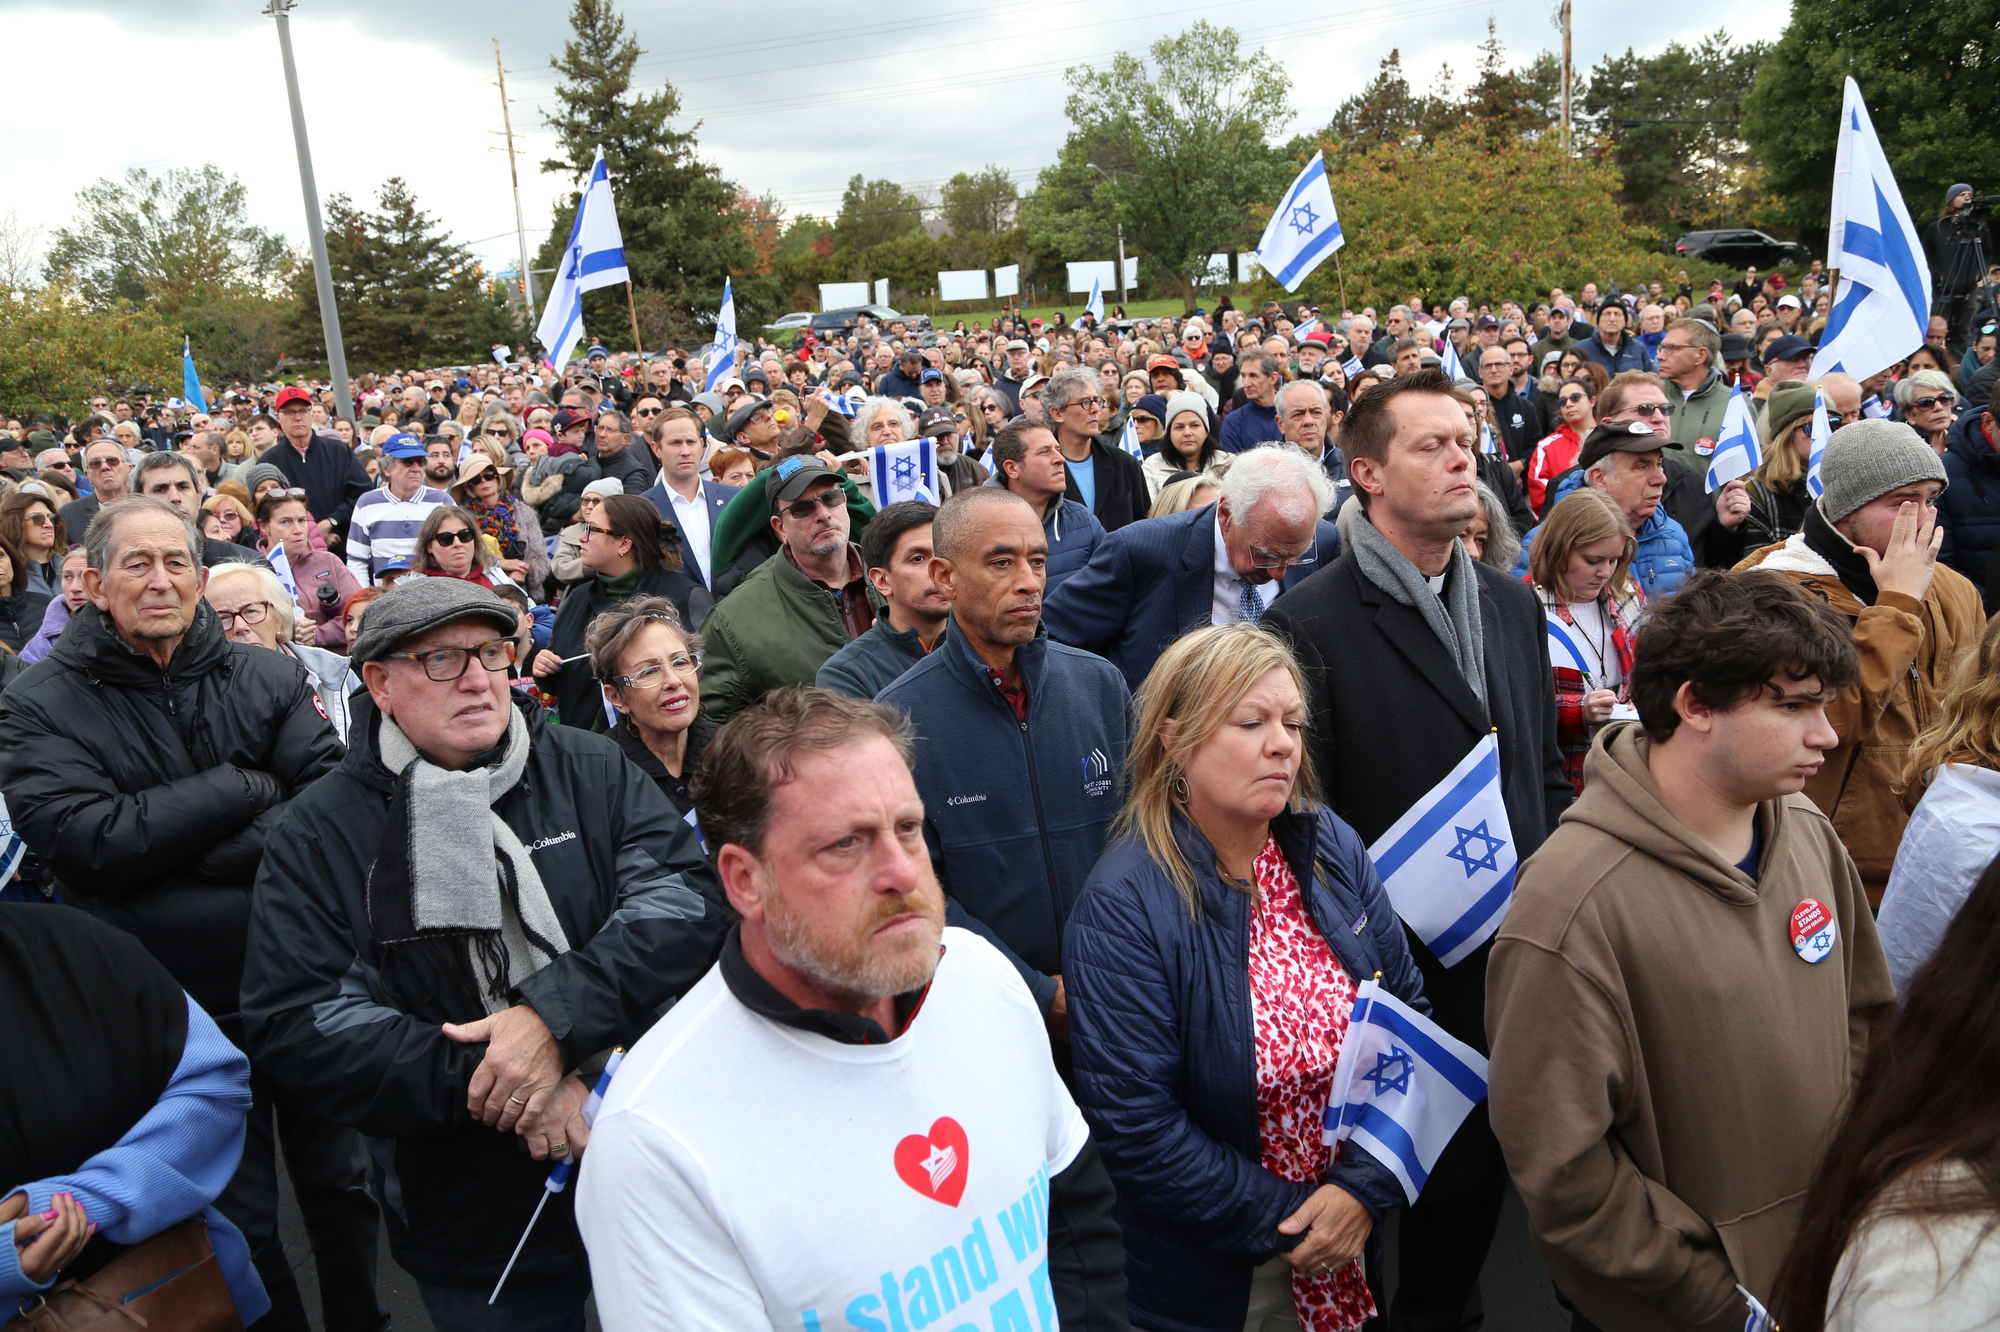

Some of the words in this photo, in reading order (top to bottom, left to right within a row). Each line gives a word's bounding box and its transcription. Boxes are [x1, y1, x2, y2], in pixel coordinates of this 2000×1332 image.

[288, 388, 298, 397] C
[567, 409, 579, 418] C
[954, 793, 987, 805] Columbia
[532, 830, 577, 850] Columbia
[1794, 901, 1819, 921] CLEVELAND
[1797, 907, 1822, 929] STANDS
[845, 1216, 1000, 1332] Stand
